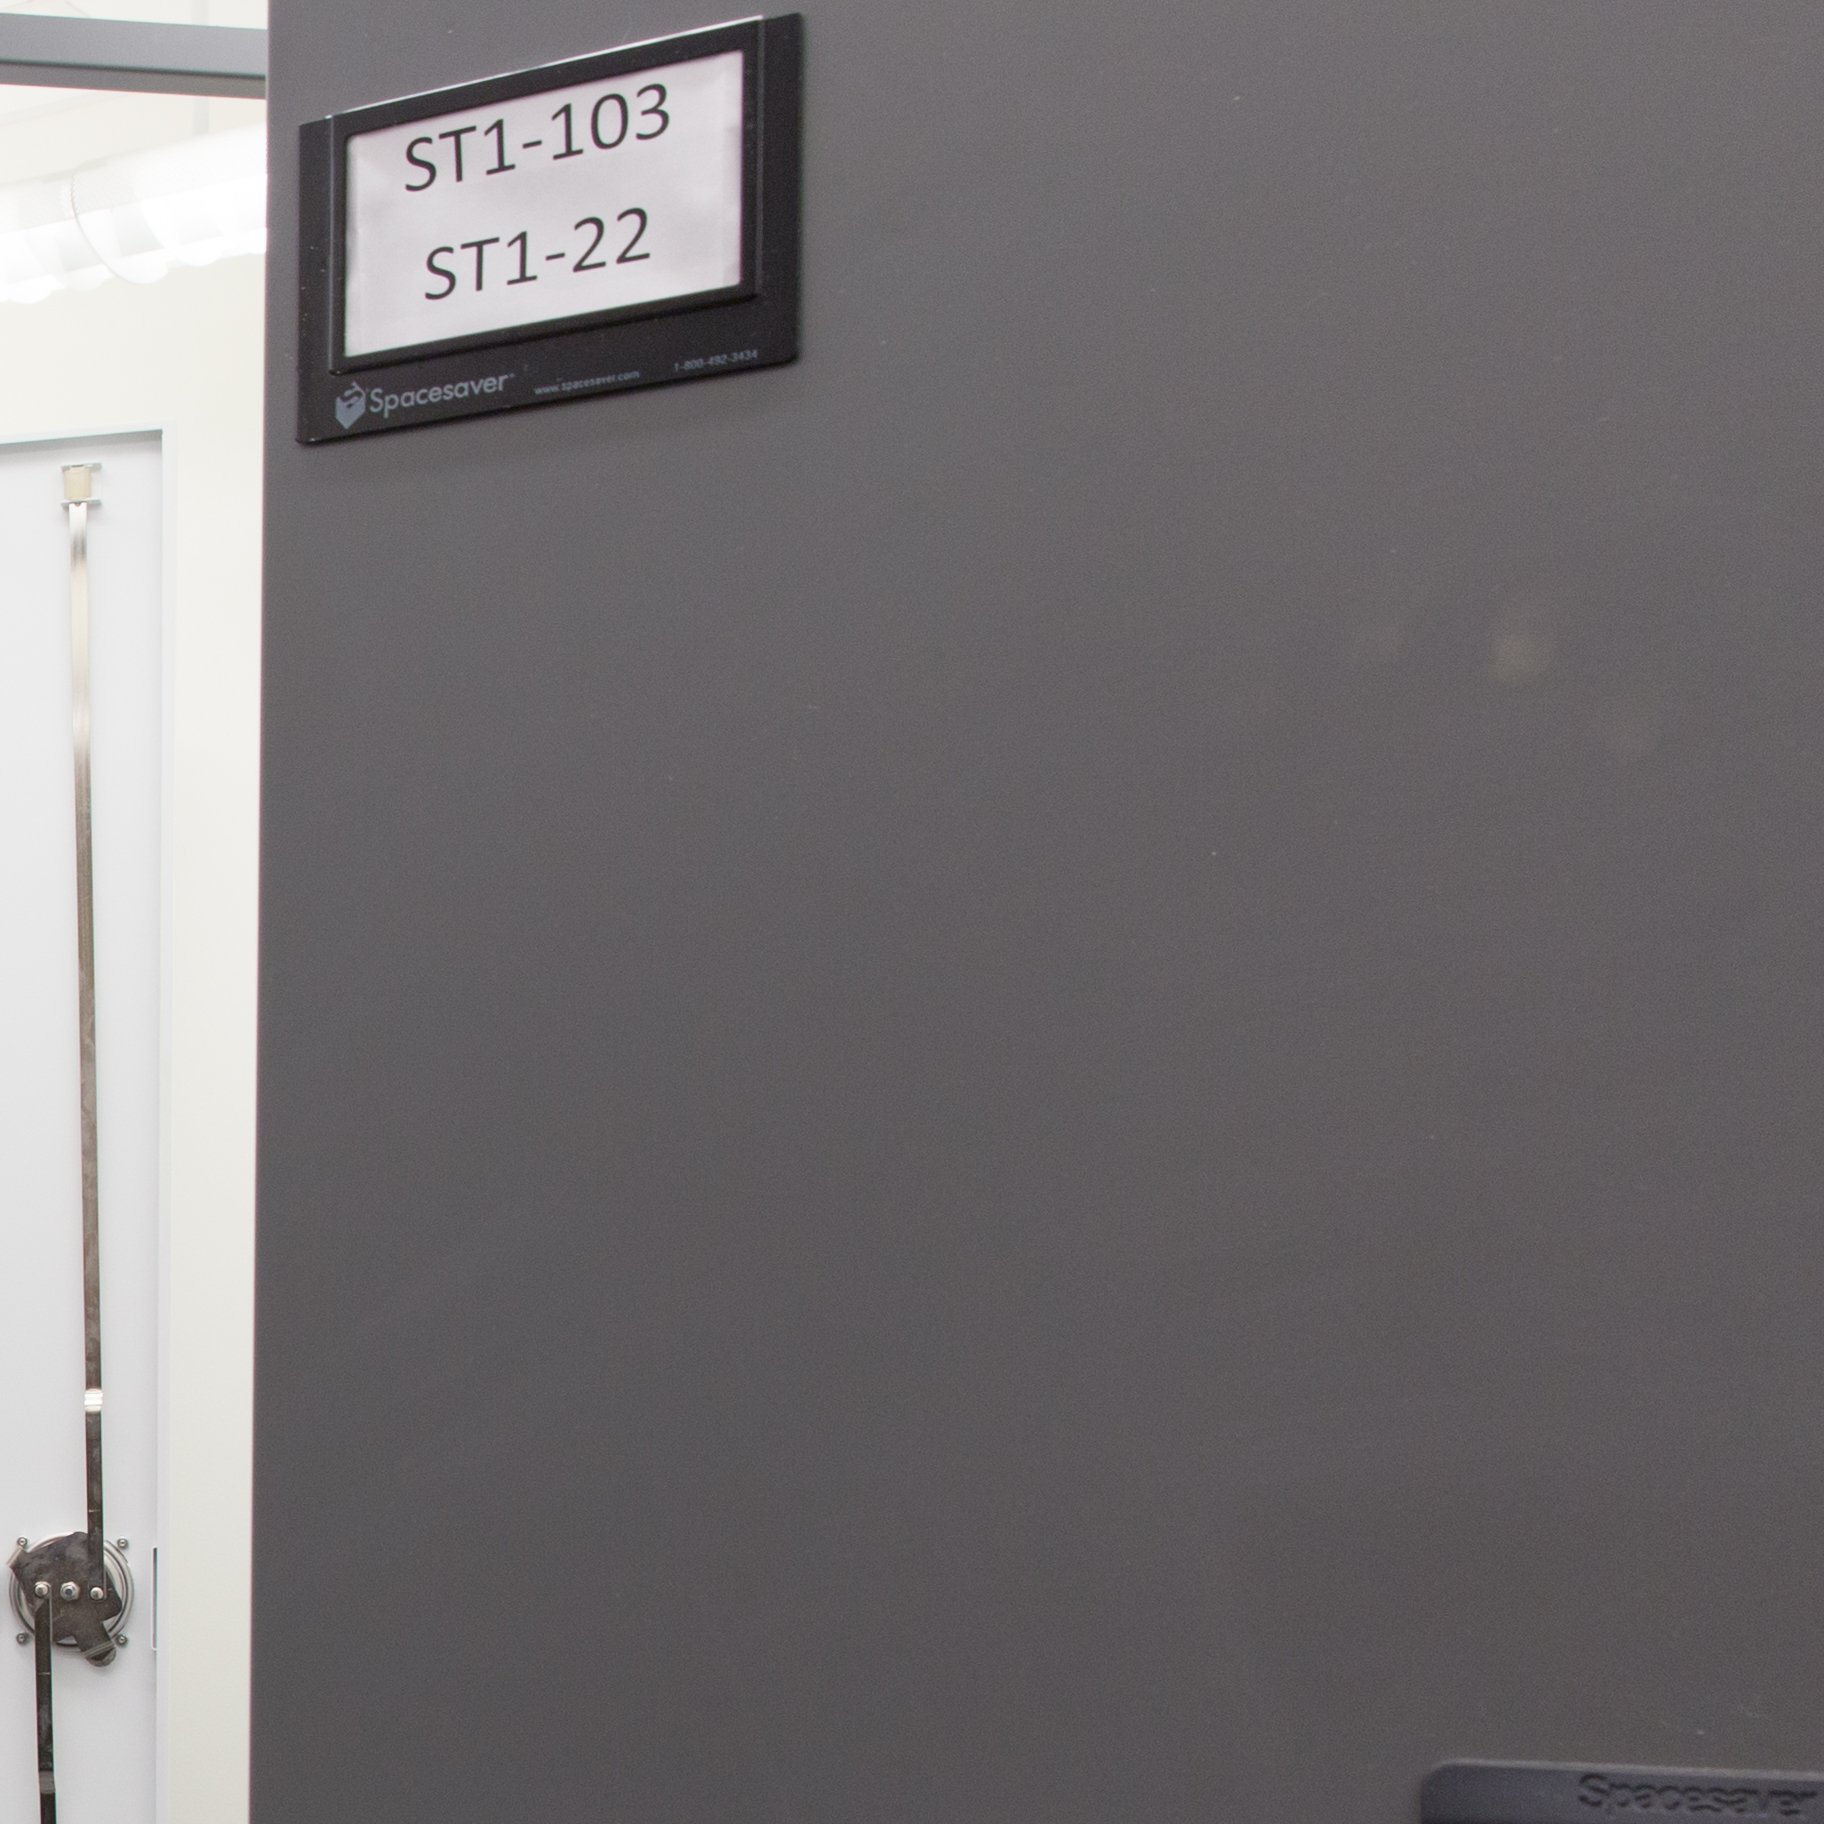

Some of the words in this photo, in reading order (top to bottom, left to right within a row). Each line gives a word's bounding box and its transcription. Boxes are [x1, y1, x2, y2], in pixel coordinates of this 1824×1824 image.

[405, 83, 670, 191] ST1-103
[424, 207, 651, 300] ST1-22
[369, 373, 510, 418] Spacesaver
